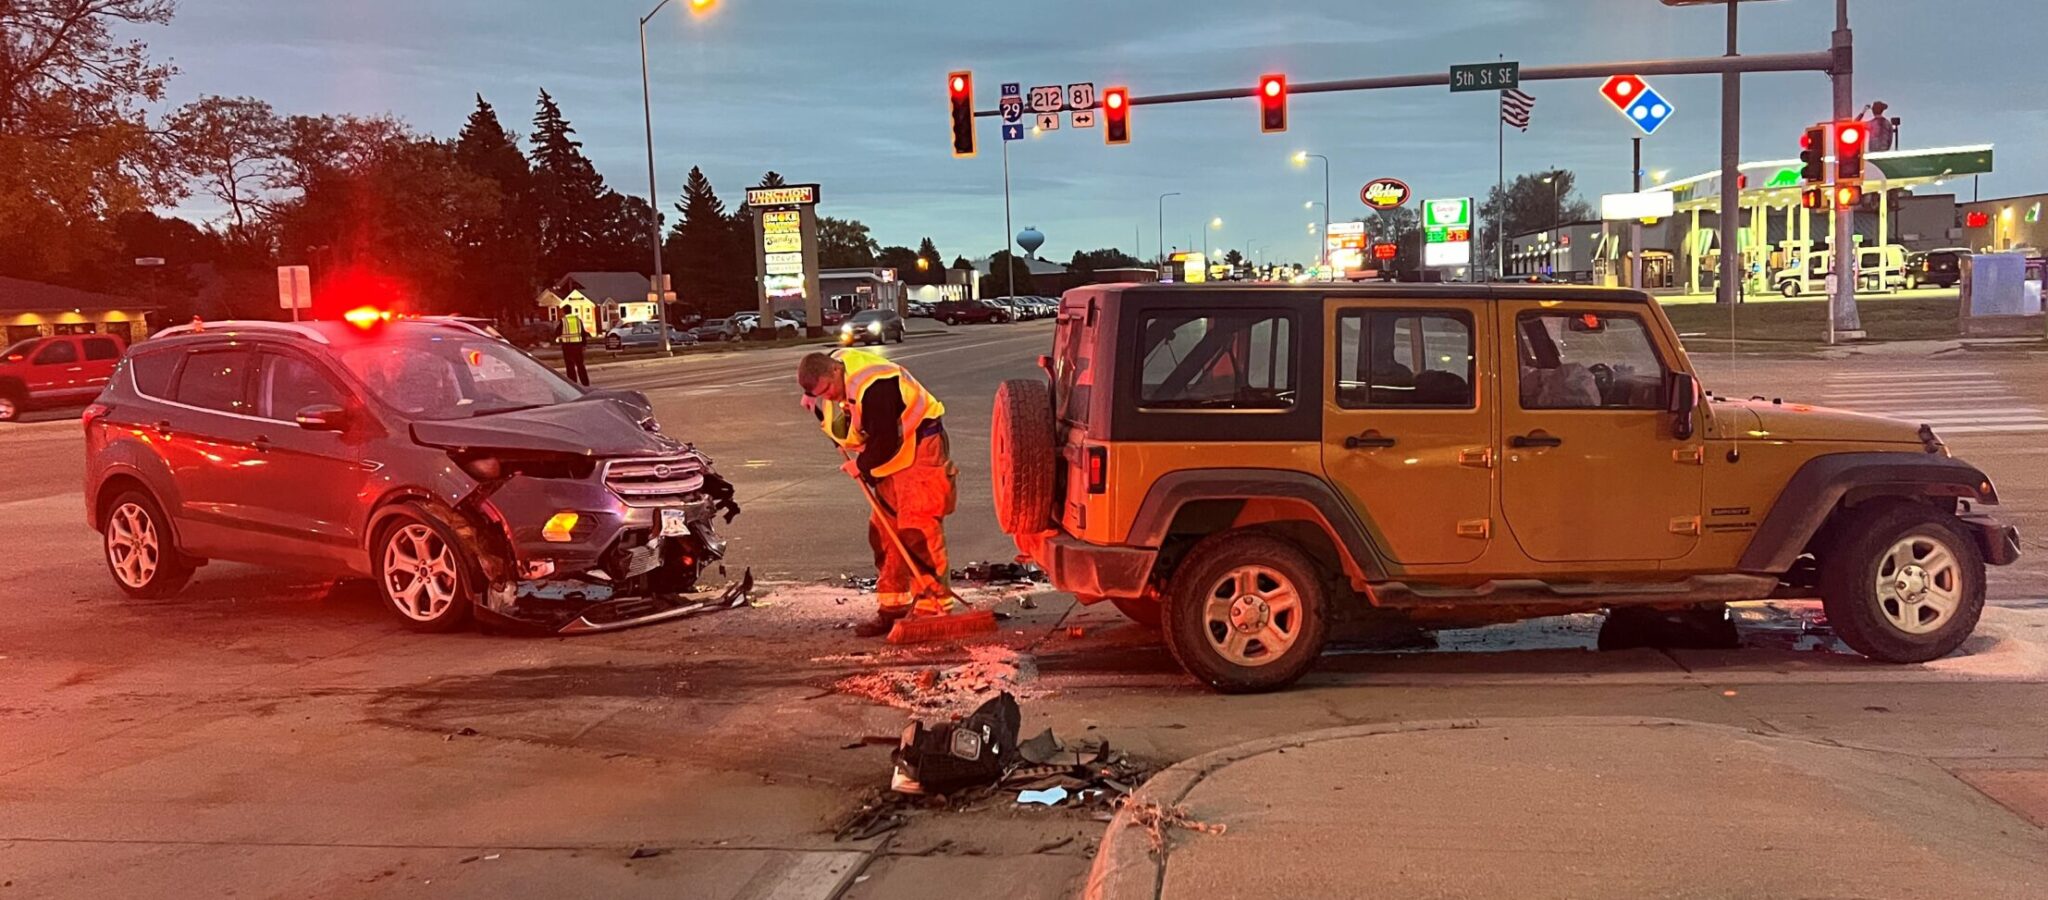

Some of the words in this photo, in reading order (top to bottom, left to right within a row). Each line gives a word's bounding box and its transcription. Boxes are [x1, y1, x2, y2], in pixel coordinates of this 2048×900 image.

[1456, 71, 1474, 86] 5th
[1480, 69, 1493, 85] St
[1499, 68, 1512, 83] SE
[1034, 92, 1060, 107] 212
[1073, 89, 1089, 104] 81
[1003, 103, 1020, 119] 29
[751, 189, 810, 202] JUNCTION
